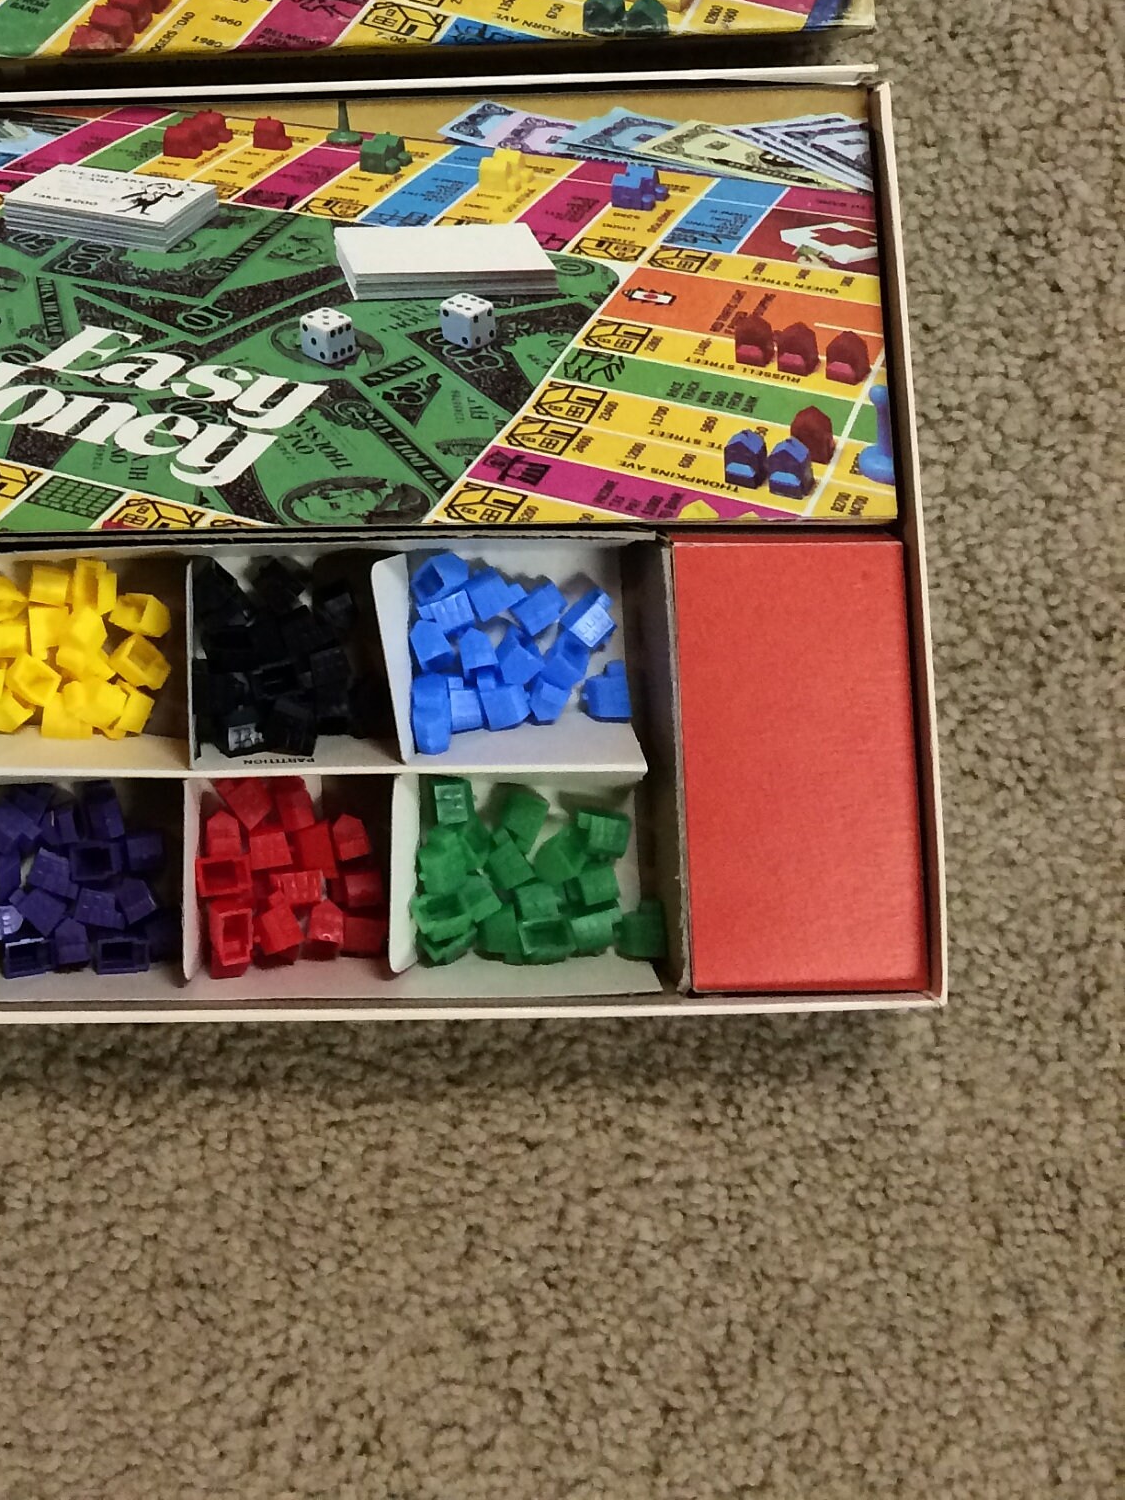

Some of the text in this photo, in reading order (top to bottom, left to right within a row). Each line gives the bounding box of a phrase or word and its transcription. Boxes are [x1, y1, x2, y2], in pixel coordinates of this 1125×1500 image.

[211, 14, 242, 26] 3960
[742, 274, 839, 295] QUEEN STREET
[29, 325, 329, 429] Easy
[685, 357, 801, 384] RUSSELL STREET
[598, 401, 619, 421] 23400
[649, 405, 670, 426] 11700
[647, 429, 701, 445] STREET
[650, 467, 740, 493] THOMPKINS
